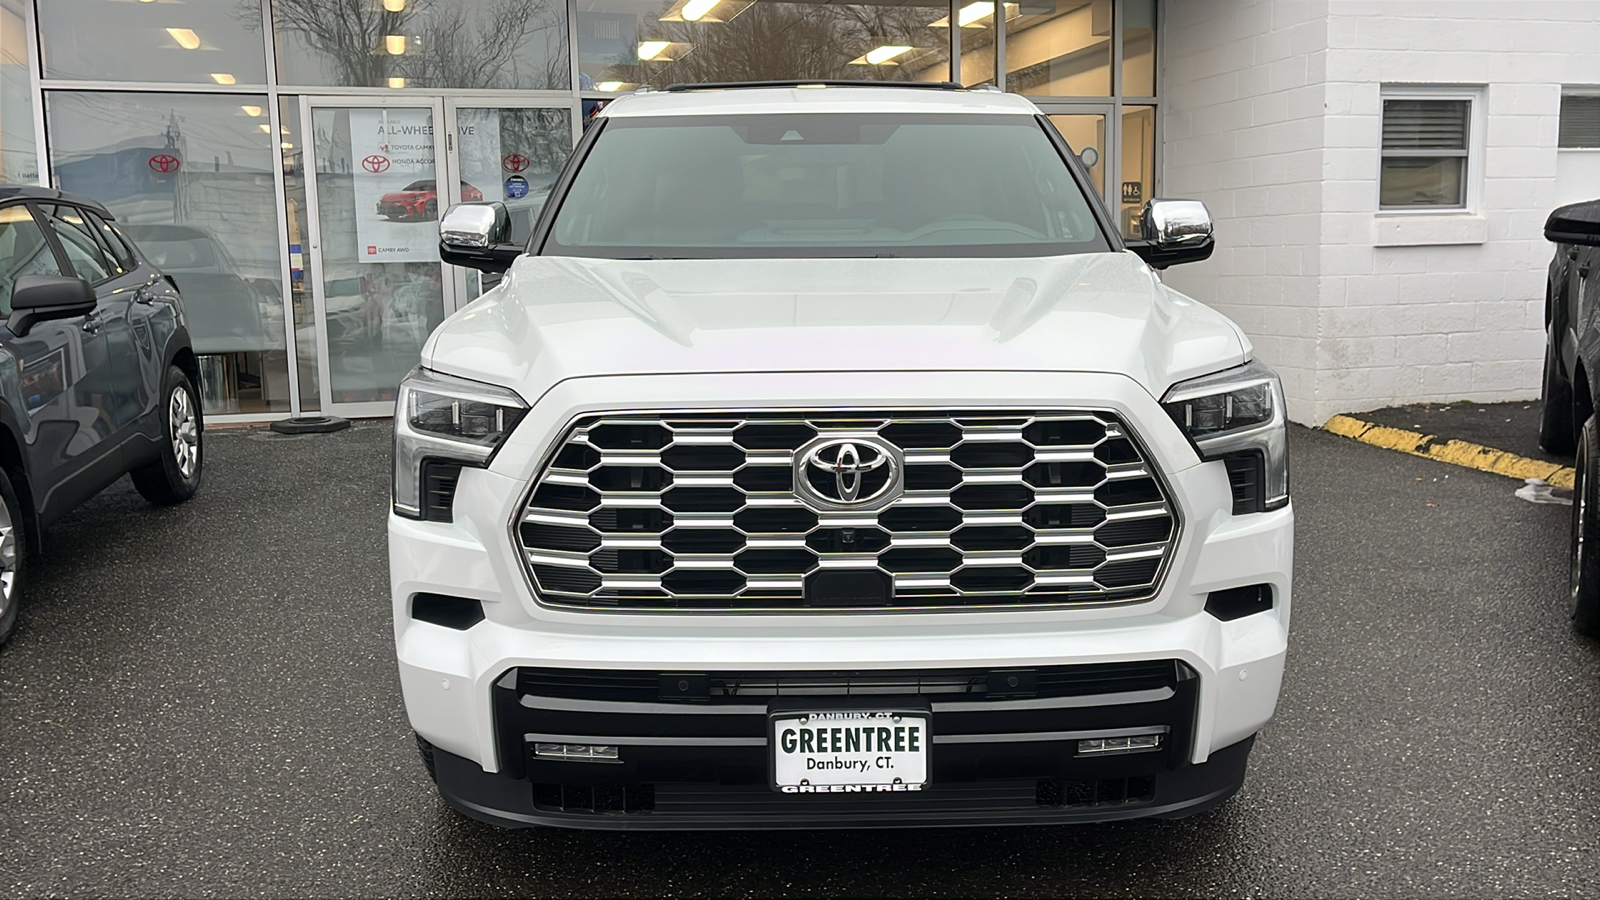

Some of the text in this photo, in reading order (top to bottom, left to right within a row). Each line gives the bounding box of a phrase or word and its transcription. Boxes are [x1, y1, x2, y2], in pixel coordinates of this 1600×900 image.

[874, 712, 893, 720] CT
[781, 726, 920, 754] GREENTREE
[806, 756, 895, 773] Danbury, CT.
[781, 783, 922, 793] GREENTREE
